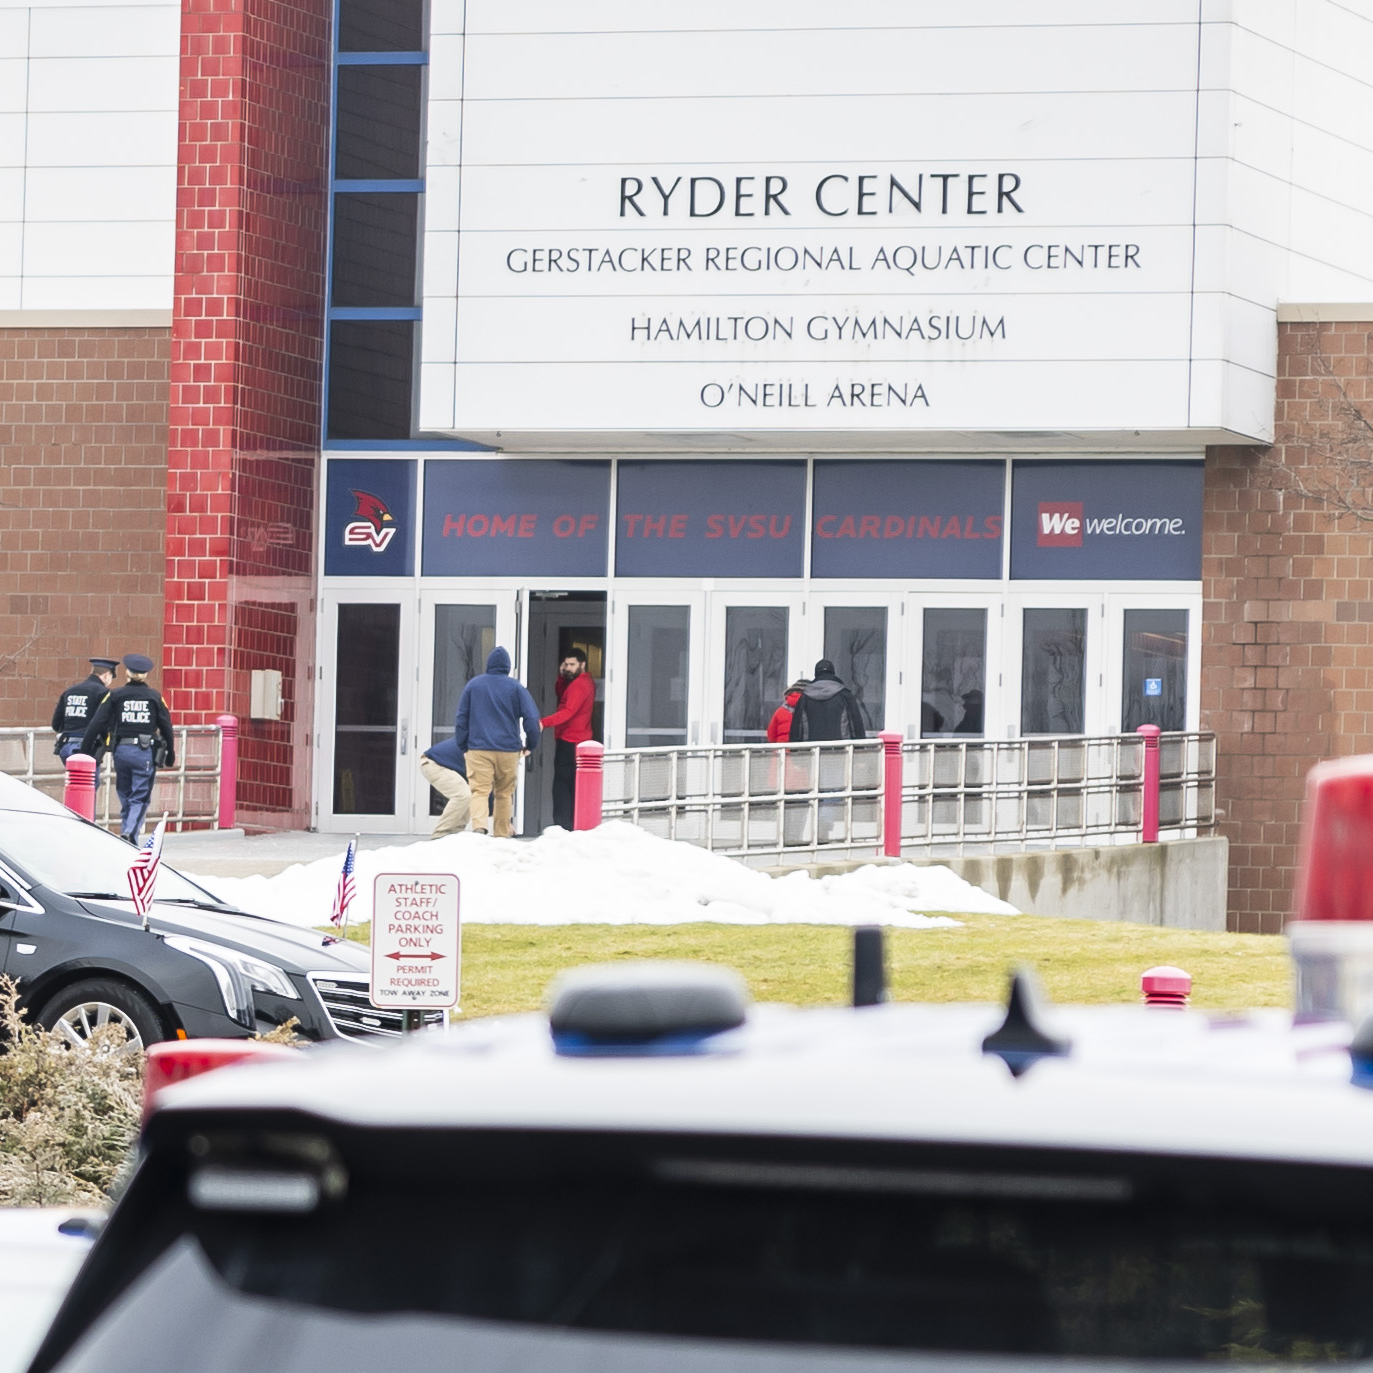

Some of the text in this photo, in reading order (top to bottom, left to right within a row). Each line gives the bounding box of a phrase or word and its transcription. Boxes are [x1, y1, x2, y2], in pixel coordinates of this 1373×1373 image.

[619, 172, 1025, 218] RYDER CENTER
[506, 244, 1142, 276] GERSTACKER REGIONAL AQUATIC CENTER
[630, 315, 1006, 341] HAMILTON GYMNASIUM
[700, 382, 931, 407] O'NEILL ARENA
[442, 513, 1003, 540] HOME OF THE SVSU CARDINALS
[1041, 512, 1186, 535] We welcome.
[67, 695, 88, 706] STATE
[124, 701, 149, 711] STATE
[65, 707, 87, 717] POLICE
[122, 712, 150, 723] POLICE
[388, 884, 446, 894] ATHLETIC
[395, 897, 438, 908] STAFF/
[394, 910, 439, 921] COACH
[388, 923, 444, 934] PARKING
[398, 937, 433, 947] ONLY
[396, 965, 434, 974] PERMIT
[389, 977, 440, 987] REQUIRED
